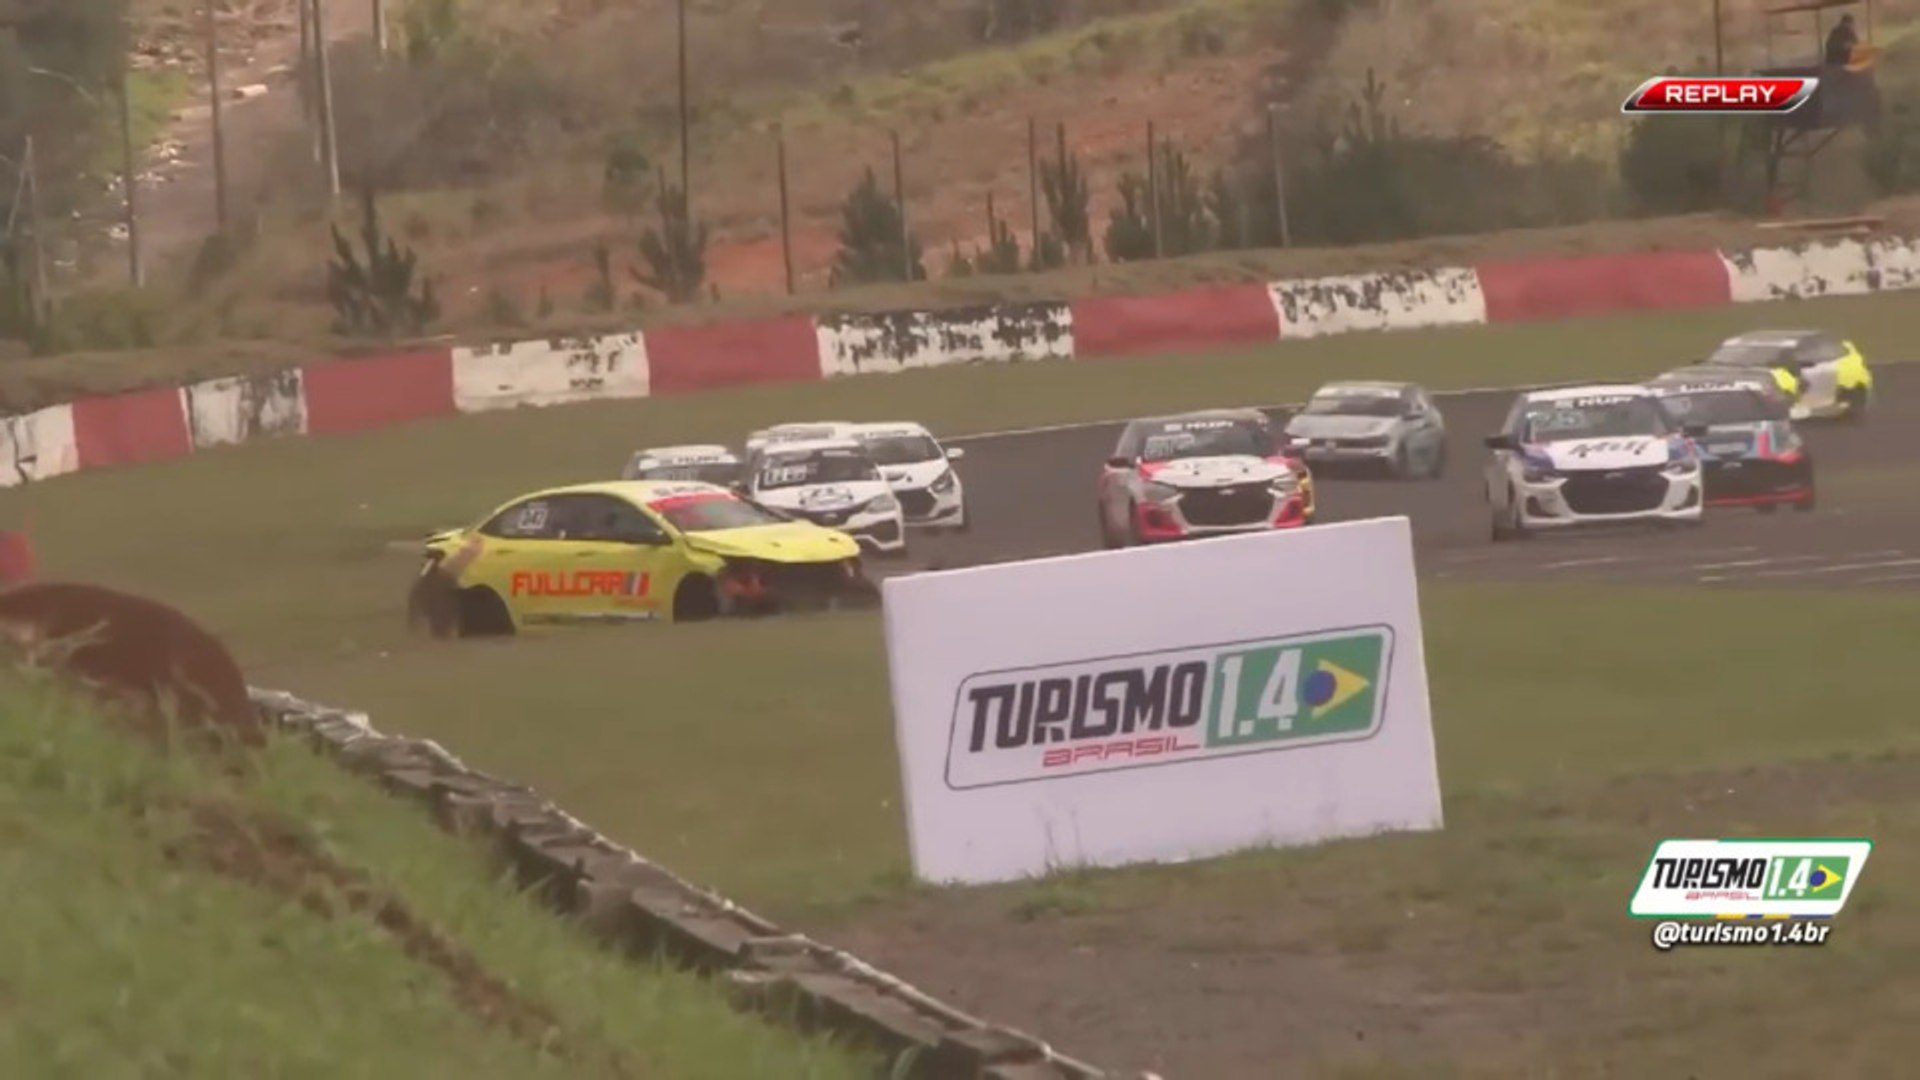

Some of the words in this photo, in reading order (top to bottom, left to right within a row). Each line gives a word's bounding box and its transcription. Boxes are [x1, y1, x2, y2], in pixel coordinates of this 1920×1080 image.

[968, 660, 1207, 753] TURISMO
[1217, 649, 1302, 738] 1.4
[1042, 735, 1201, 767] BRASIL
